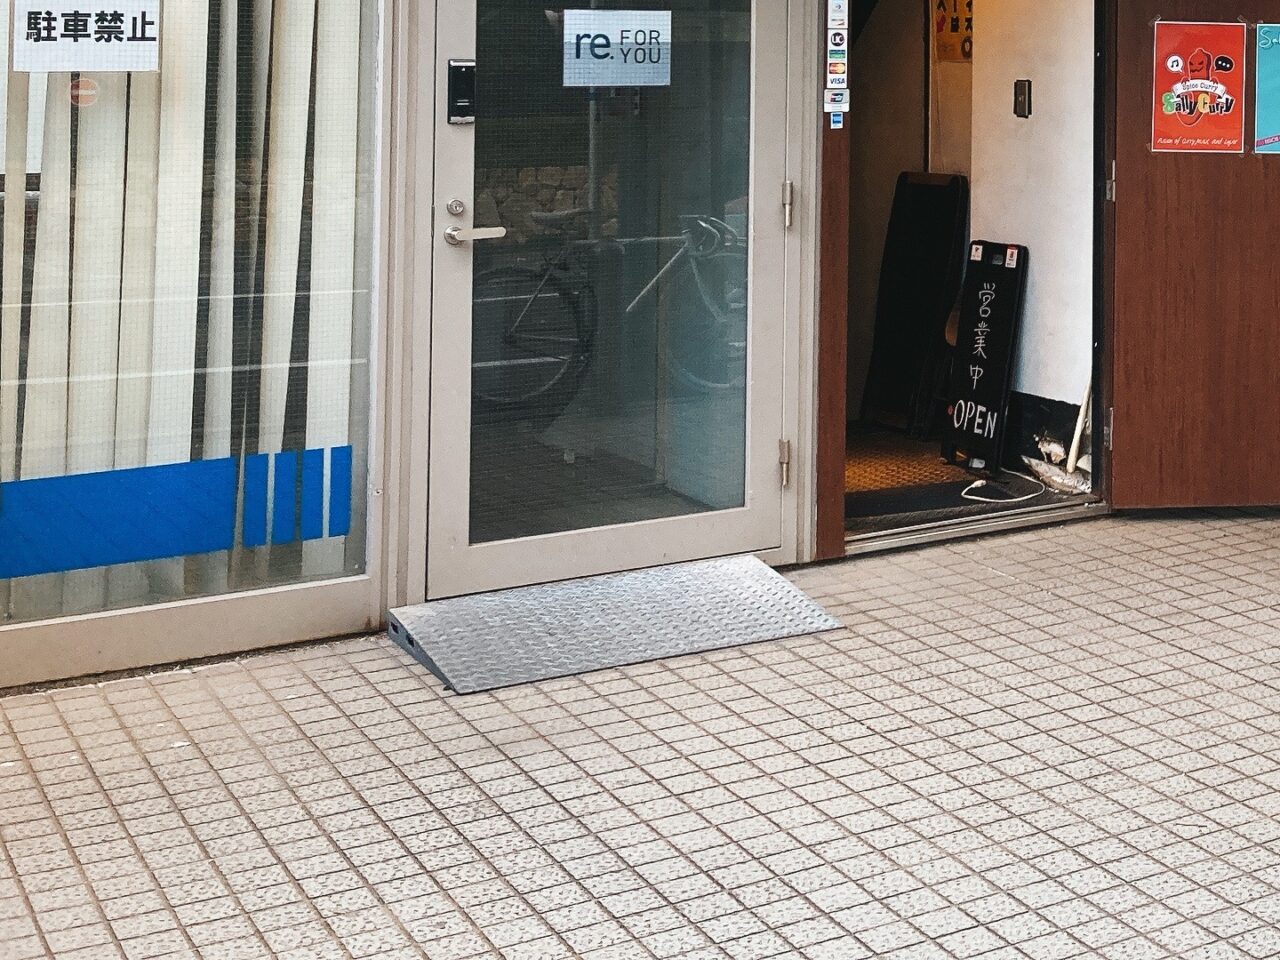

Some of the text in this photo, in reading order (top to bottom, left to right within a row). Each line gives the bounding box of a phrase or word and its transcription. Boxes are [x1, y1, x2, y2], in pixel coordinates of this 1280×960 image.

[26, 10, 157, 43] 駐車禁止
[620, 29, 660, 46] FOR
[620, 47, 660, 64] YOU
[970, 282, 996, 390] 営業中
[953, 400, 997, 439] OPEN
